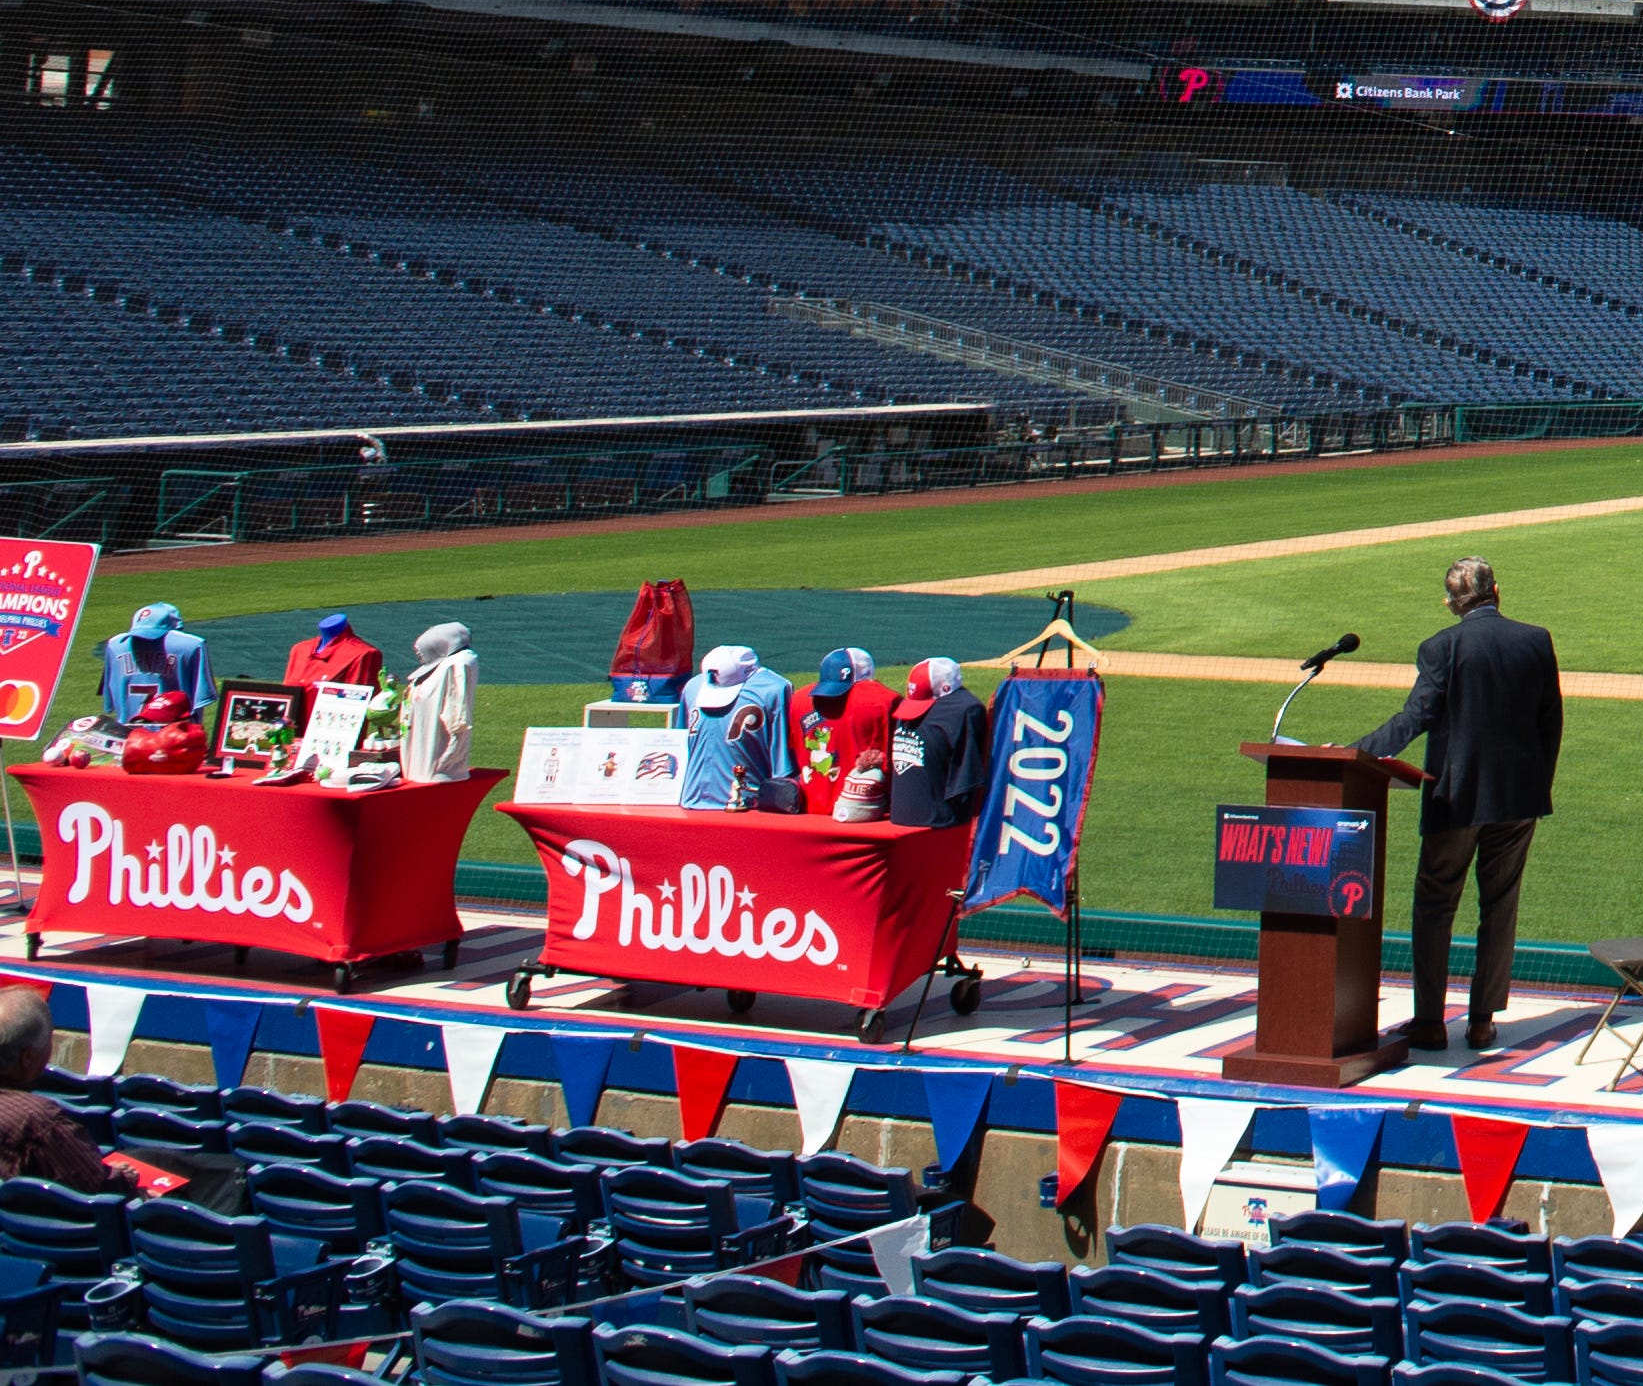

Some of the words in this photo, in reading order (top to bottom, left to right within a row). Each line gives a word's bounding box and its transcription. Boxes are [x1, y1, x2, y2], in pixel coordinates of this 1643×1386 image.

[1179, 68, 1208, 103] P
[1355, 85, 1403, 99] Citizens
[1404, 86, 1433, 100] Bank
[1435, 88, 1461, 101] Park
[23, 550, 42, 579] P
[726, 704, 764, 743] P
[999, 709, 1074, 857] 2022
[59, 801, 314, 923] Phillies
[1219, 823, 1287, 864] WHAT'S
[1285, 826, 1334, 868] NEW!
[562, 838, 839, 966] Phillies
[1341, 882, 1365, 915] P
